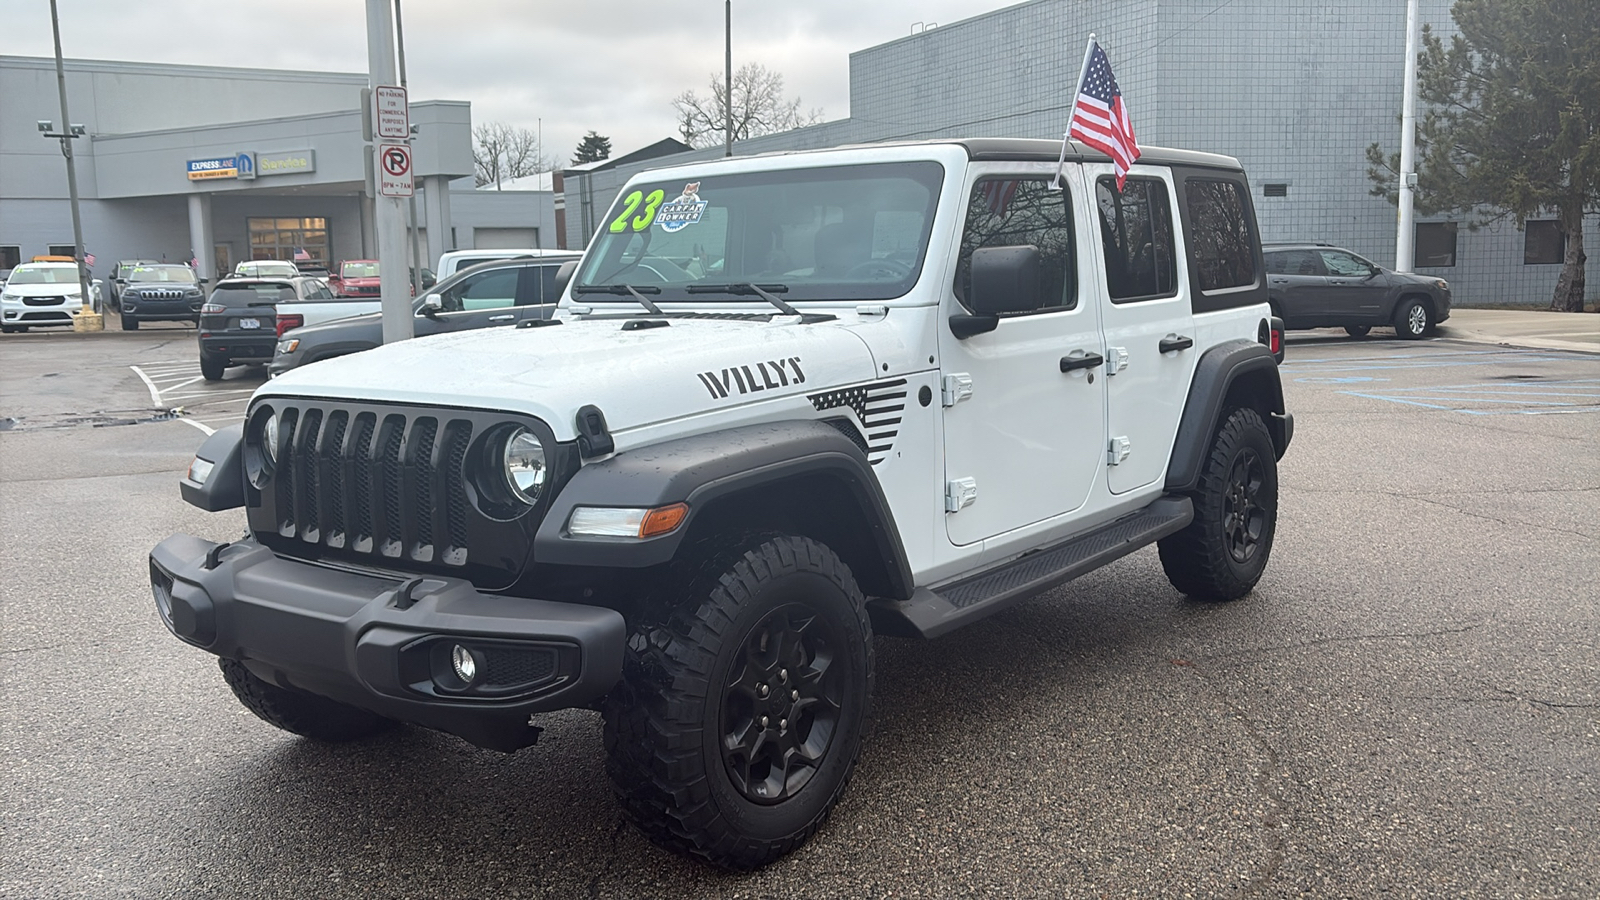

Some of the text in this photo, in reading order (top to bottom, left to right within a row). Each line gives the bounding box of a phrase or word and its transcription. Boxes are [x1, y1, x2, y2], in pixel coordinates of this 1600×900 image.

[262, 157, 307, 171] Service
[609, 189, 665, 233] 23
[663, 203, 702, 213] CARFAX
[665, 213, 699, 221] OWNER
[697, 356, 806, 400] WILLYS
